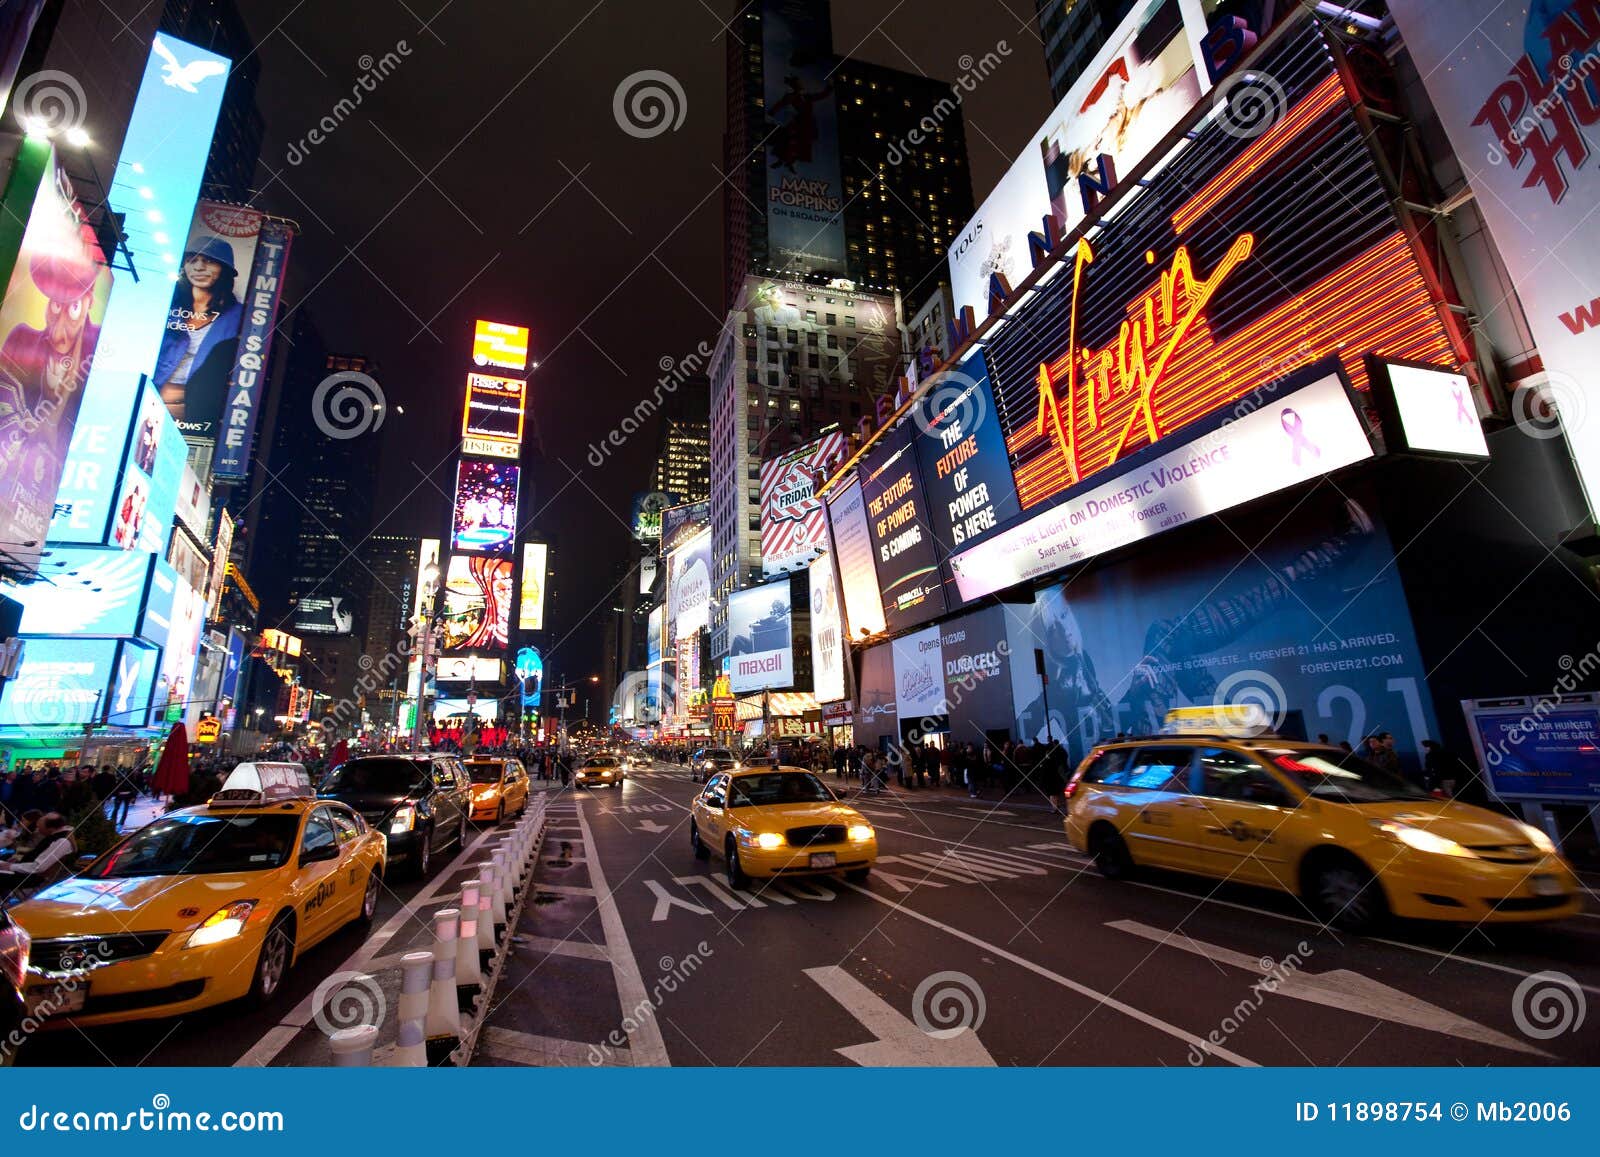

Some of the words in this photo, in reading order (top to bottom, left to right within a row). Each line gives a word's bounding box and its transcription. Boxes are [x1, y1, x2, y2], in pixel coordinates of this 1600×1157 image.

[780, 176, 829, 195] MARY
[770, 187, 841, 211] POPPINS
[772, 208, 787, 218] ON
[789, 209, 840, 225] BROADWAY
[953, 219, 983, 262] TOUS
[251, 241, 283, 326] TIMES
[167, 319, 195, 332] idea
[211, 312, 220, 322] 7
[1037, 232, 1254, 484] Virgin
[225, 335, 263, 446] SQUARE
[473, 377, 504, 390] HSBC
[204, 421, 212, 431] 7
[940, 419, 963, 450] THE
[464, 440, 494, 453] HSBC
[936, 434, 979, 480] FUTURE
[221, 458, 238, 466] NYC
[953, 467, 969, 492] OF
[868, 497, 884, 518] THE
[883, 472, 914, 511] FUTURE
[948, 482, 990, 522] POWER
[1039, 518, 1068, 541] LIGHT
[1069, 509, 1086, 526] ON
[1085, 480, 1154, 519] DOMESTIC
[1151, 445, 1233, 489] VIOLENCE
[877, 518, 888, 538] OF
[887, 500, 916, 533] POWER
[952, 525, 965, 546] IS
[965, 505, 997, 537] HERE
[1173, 511, 1188, 524] 311
[1038, 543, 1057, 560] SAVE
[1057, 539, 1071, 553] THE
[1128, 502, 1168, 523] YORKER
[881, 545, 890, 562] IS
[890, 525, 922, 556] COMING
[400, 583, 411, 630] NOVOTEL
[897, 586, 924, 604] DURACELL
[918, 638, 940, 653] Opens
[940, 630, 966, 648] 11/23/09
[1249, 645, 1296, 663] FOREVER
[1298, 644, 1310, 656] 21
[1312, 640, 1338, 655] HAS
[1340, 632, 1400, 652] ARRIVED.
[738, 655, 782, 676] maxell
[946, 650, 1001, 676] DURACELL
[987, 667, 1000, 677] LAB
[1183, 660, 1193, 671] IS
[1300, 653, 1404, 676] FOREVER21.COM
[1538, 732, 1549, 740] AT
[1551, 732, 1569, 740] THE
[1555, 720, 1592, 731] HUNGER
